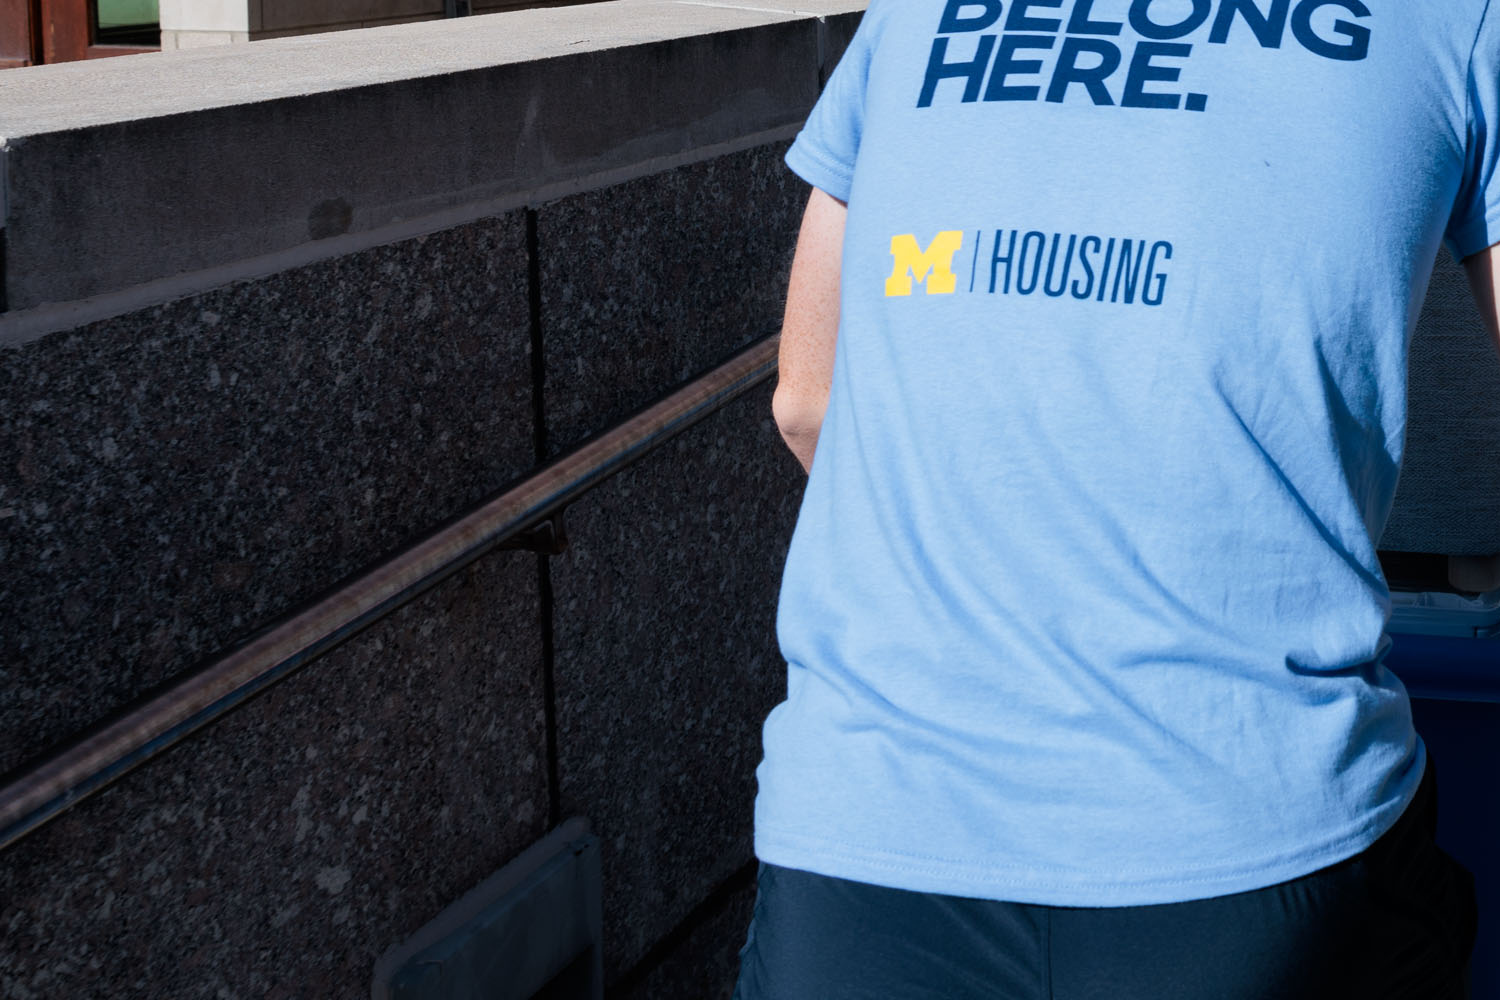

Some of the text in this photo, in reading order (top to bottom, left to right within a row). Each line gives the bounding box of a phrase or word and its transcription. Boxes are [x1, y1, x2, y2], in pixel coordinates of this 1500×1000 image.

[916, 34, 1208, 112] HERE.
[885, 229, 1173, 306] M HOUSING
